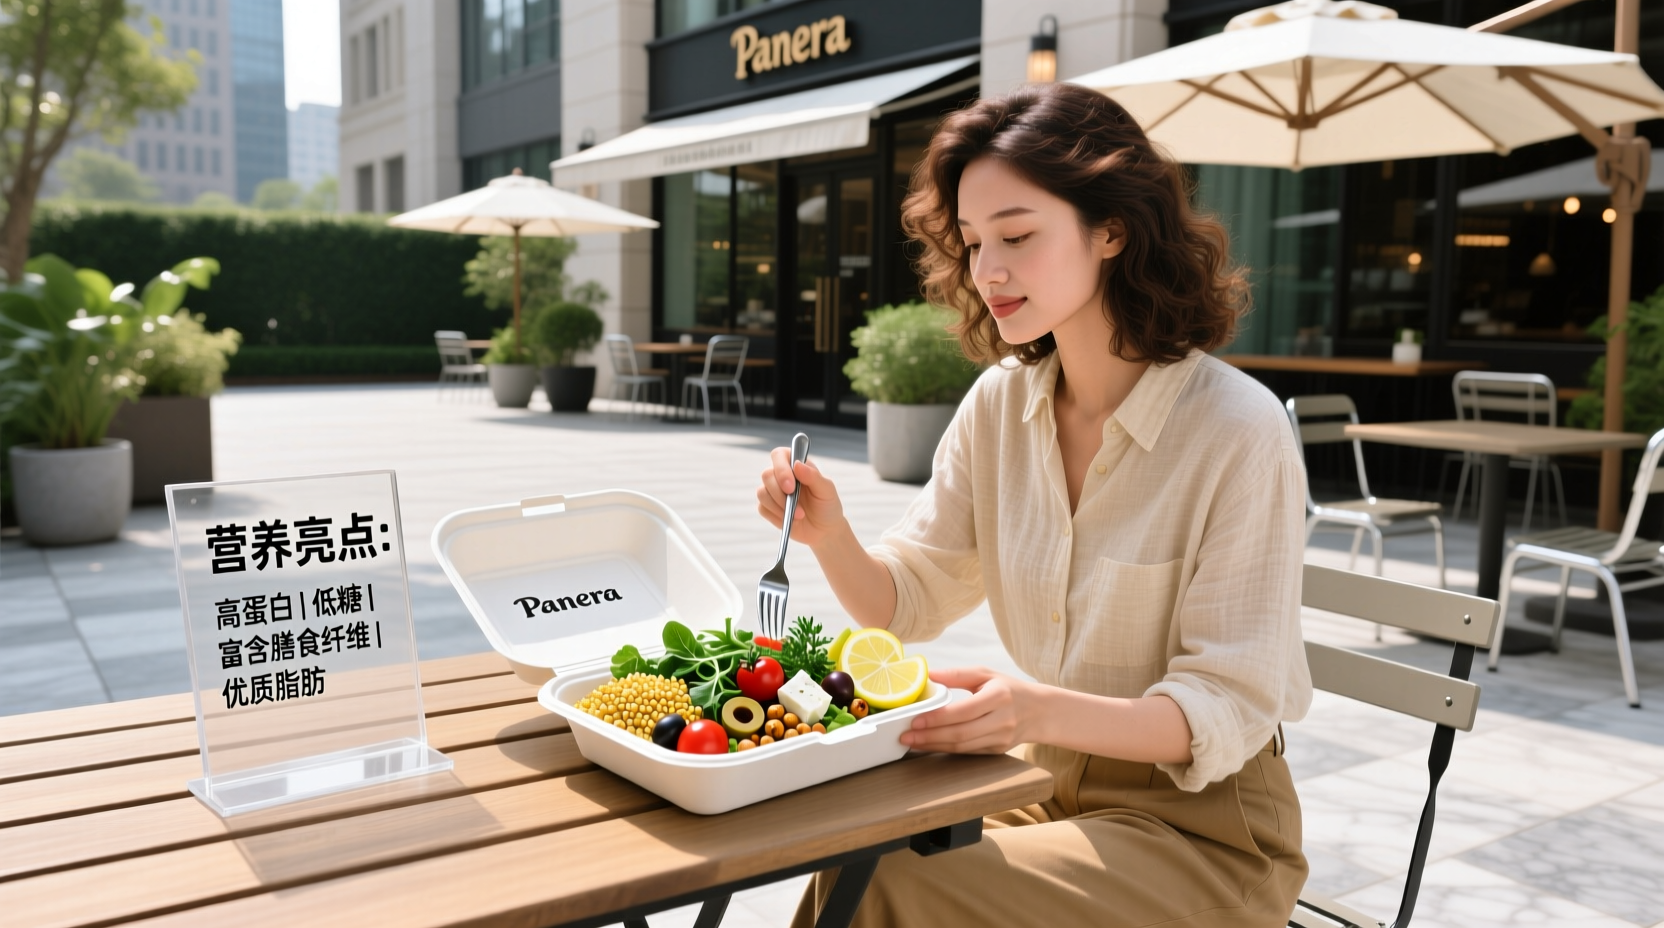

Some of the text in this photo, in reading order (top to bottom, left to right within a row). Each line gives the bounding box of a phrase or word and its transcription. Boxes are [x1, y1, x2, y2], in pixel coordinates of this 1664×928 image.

[730, 14, 851, 80] Panera
[513, 588, 623, 618] Panera
[222, 665, 326, 710] 优质脂肪
